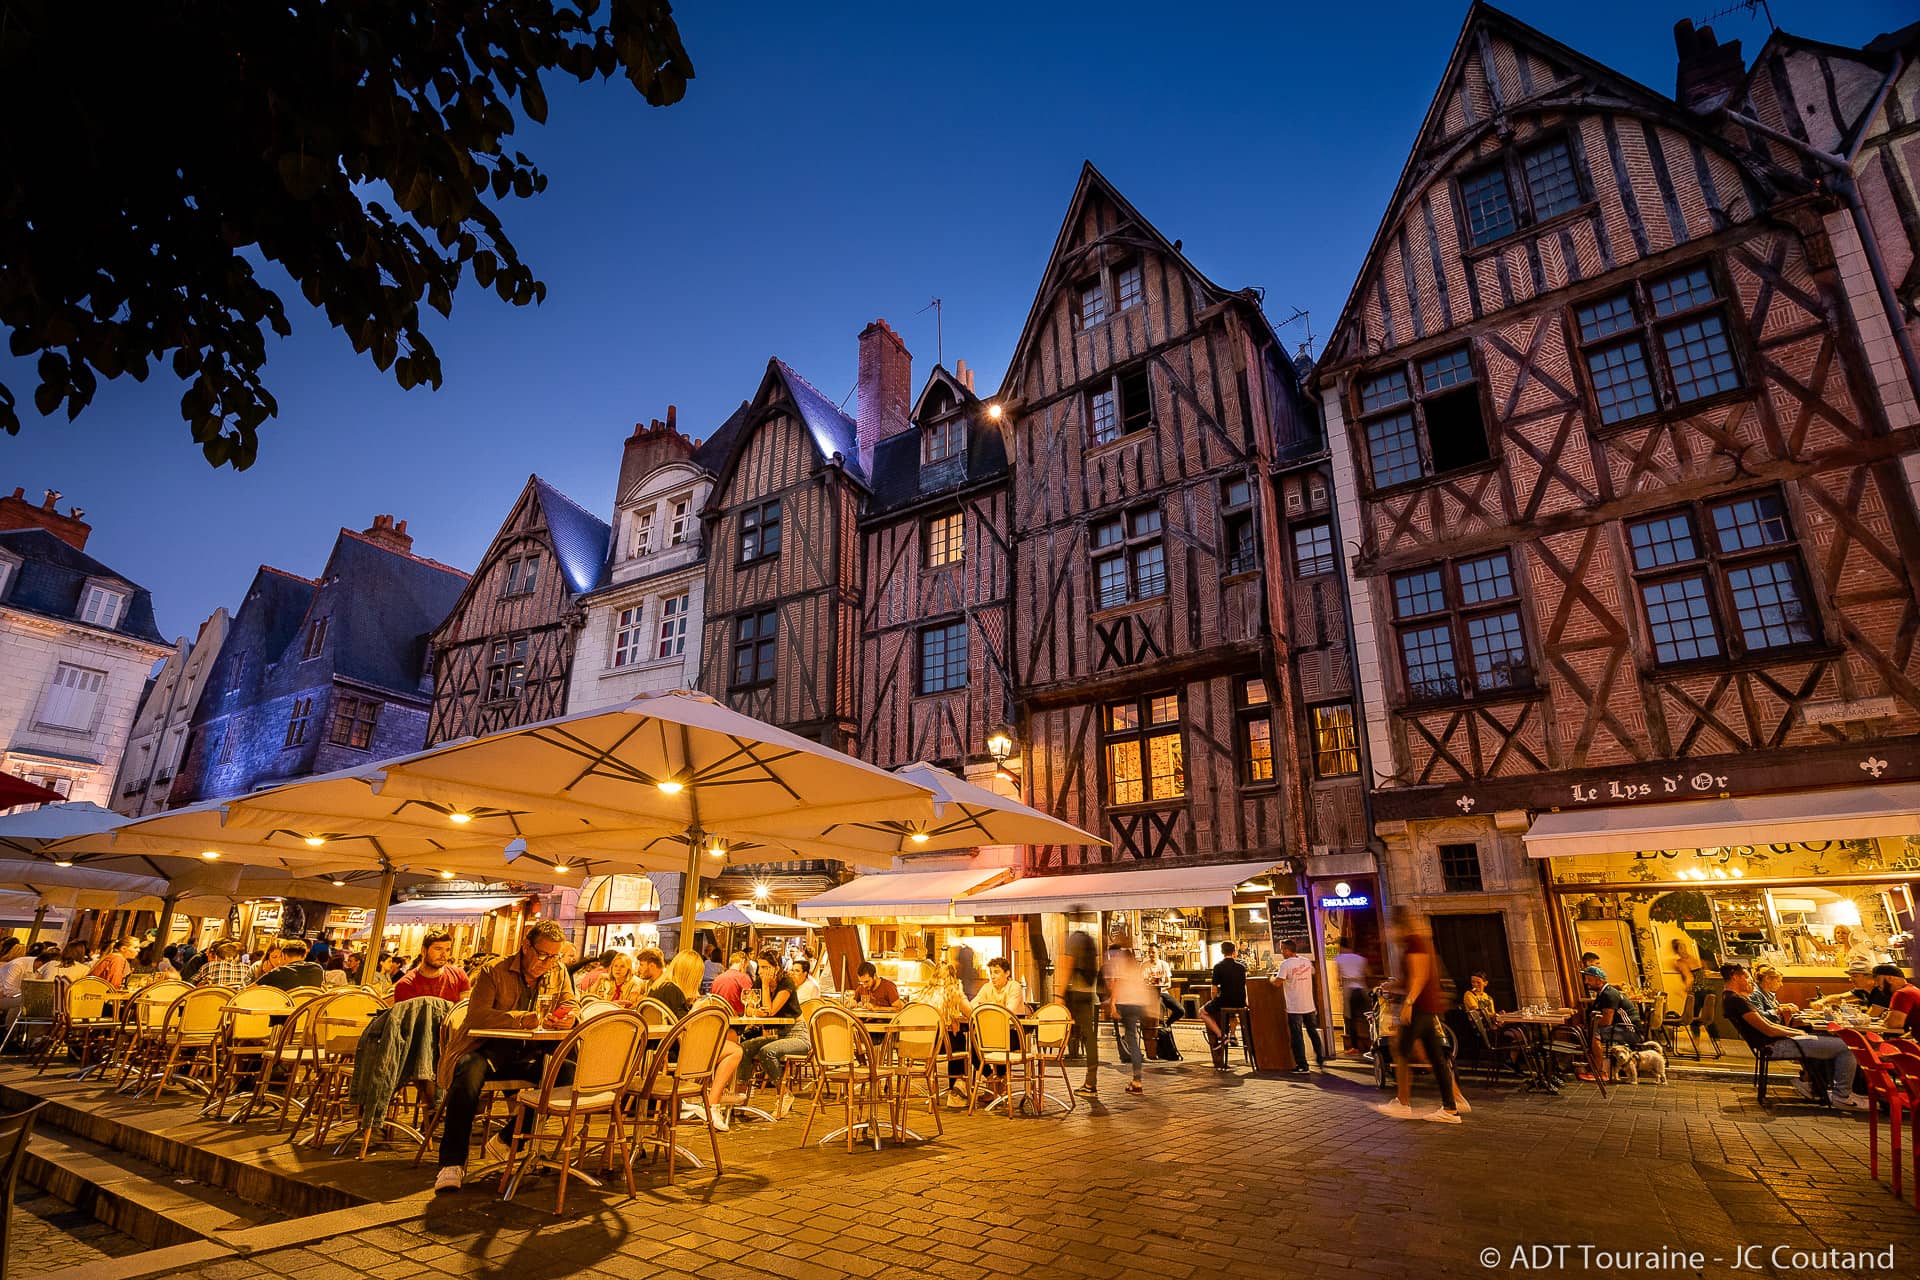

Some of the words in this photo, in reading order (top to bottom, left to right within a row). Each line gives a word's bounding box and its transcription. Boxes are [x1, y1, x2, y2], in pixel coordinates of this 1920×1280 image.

[1810, 711, 1845, 721] GRAND
[1571, 784, 1598, 802] Le
[1608, 780, 1652, 800] Lys
